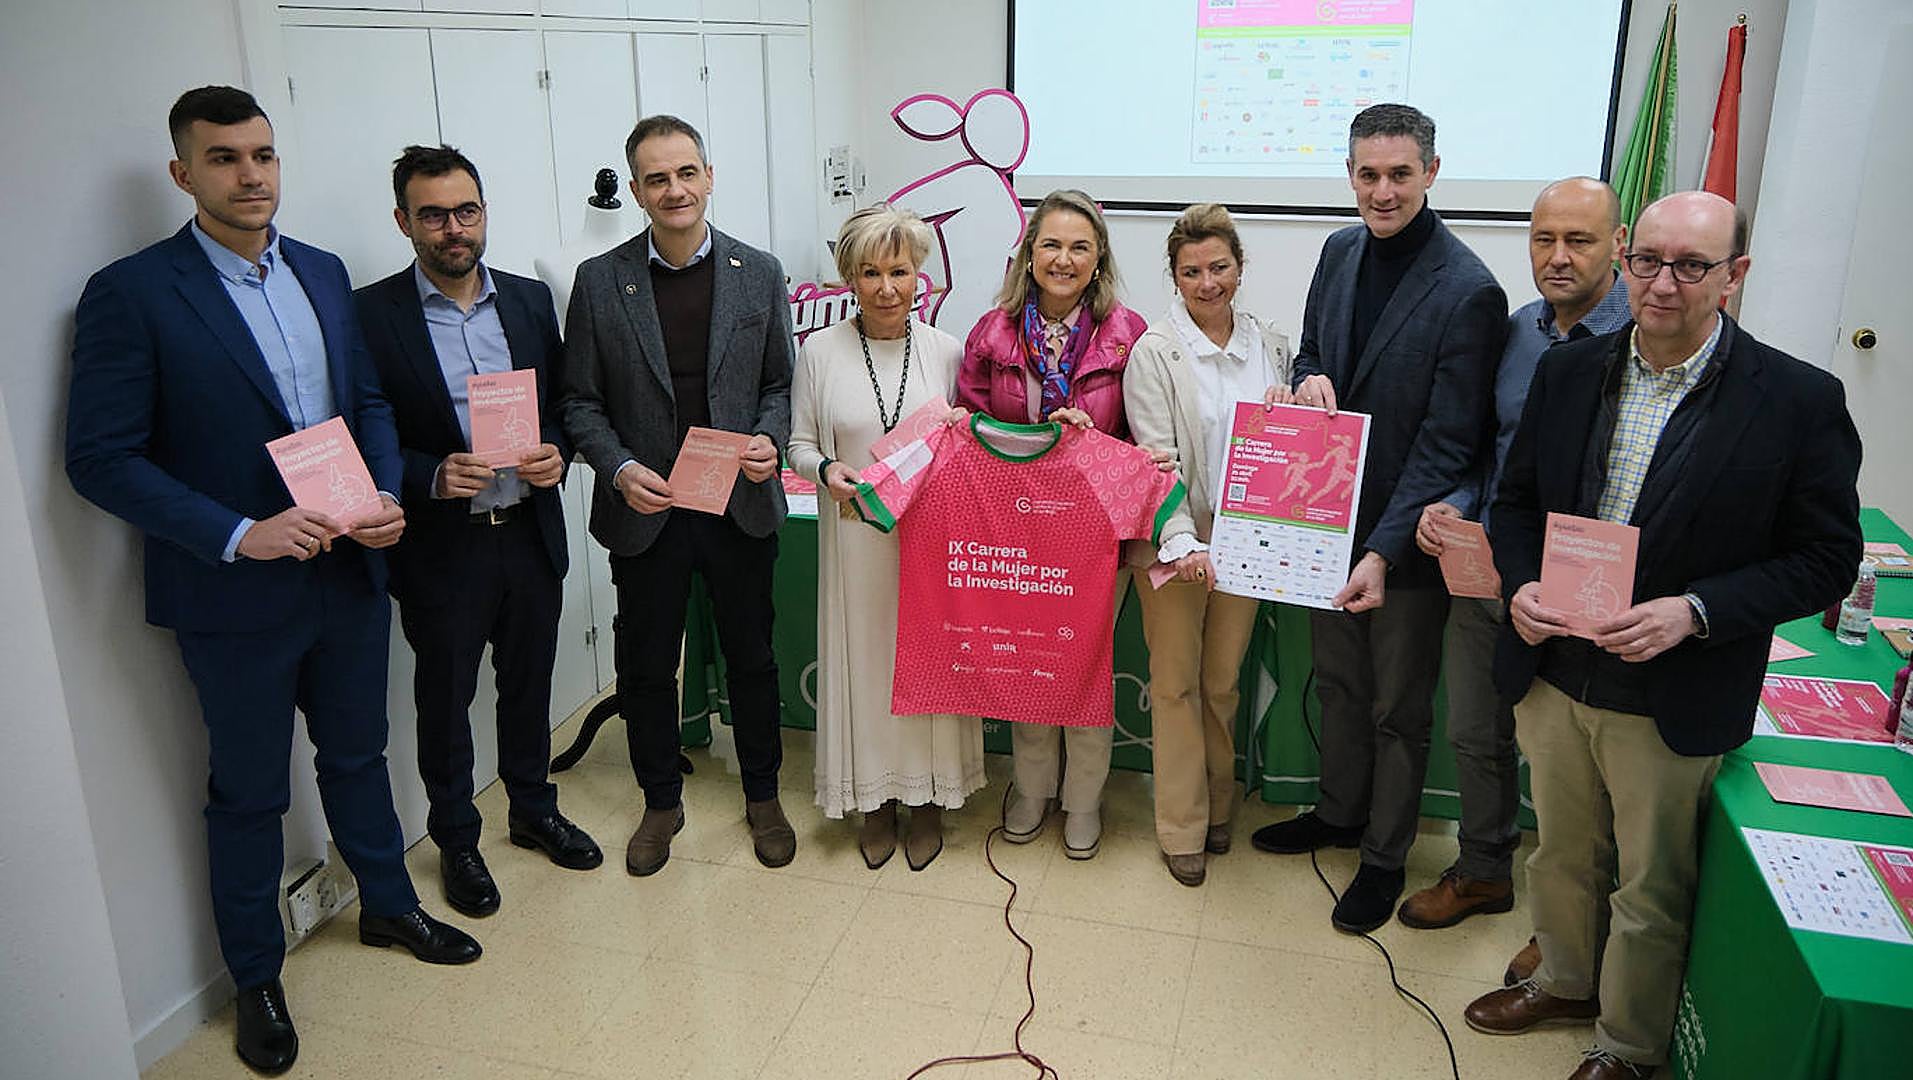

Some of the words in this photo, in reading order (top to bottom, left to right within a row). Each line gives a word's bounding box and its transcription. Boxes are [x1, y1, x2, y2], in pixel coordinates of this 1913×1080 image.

[948, 541, 964, 555] IX
[967, 541, 1028, 559] Carrera
[948, 558, 968, 572] de
[972, 558, 988, 572] la
[991, 560, 1037, 577] Mujer
[1040, 566, 1069, 580] por
[948, 573, 962, 587] la
[966, 574, 1074, 596] Investigación
